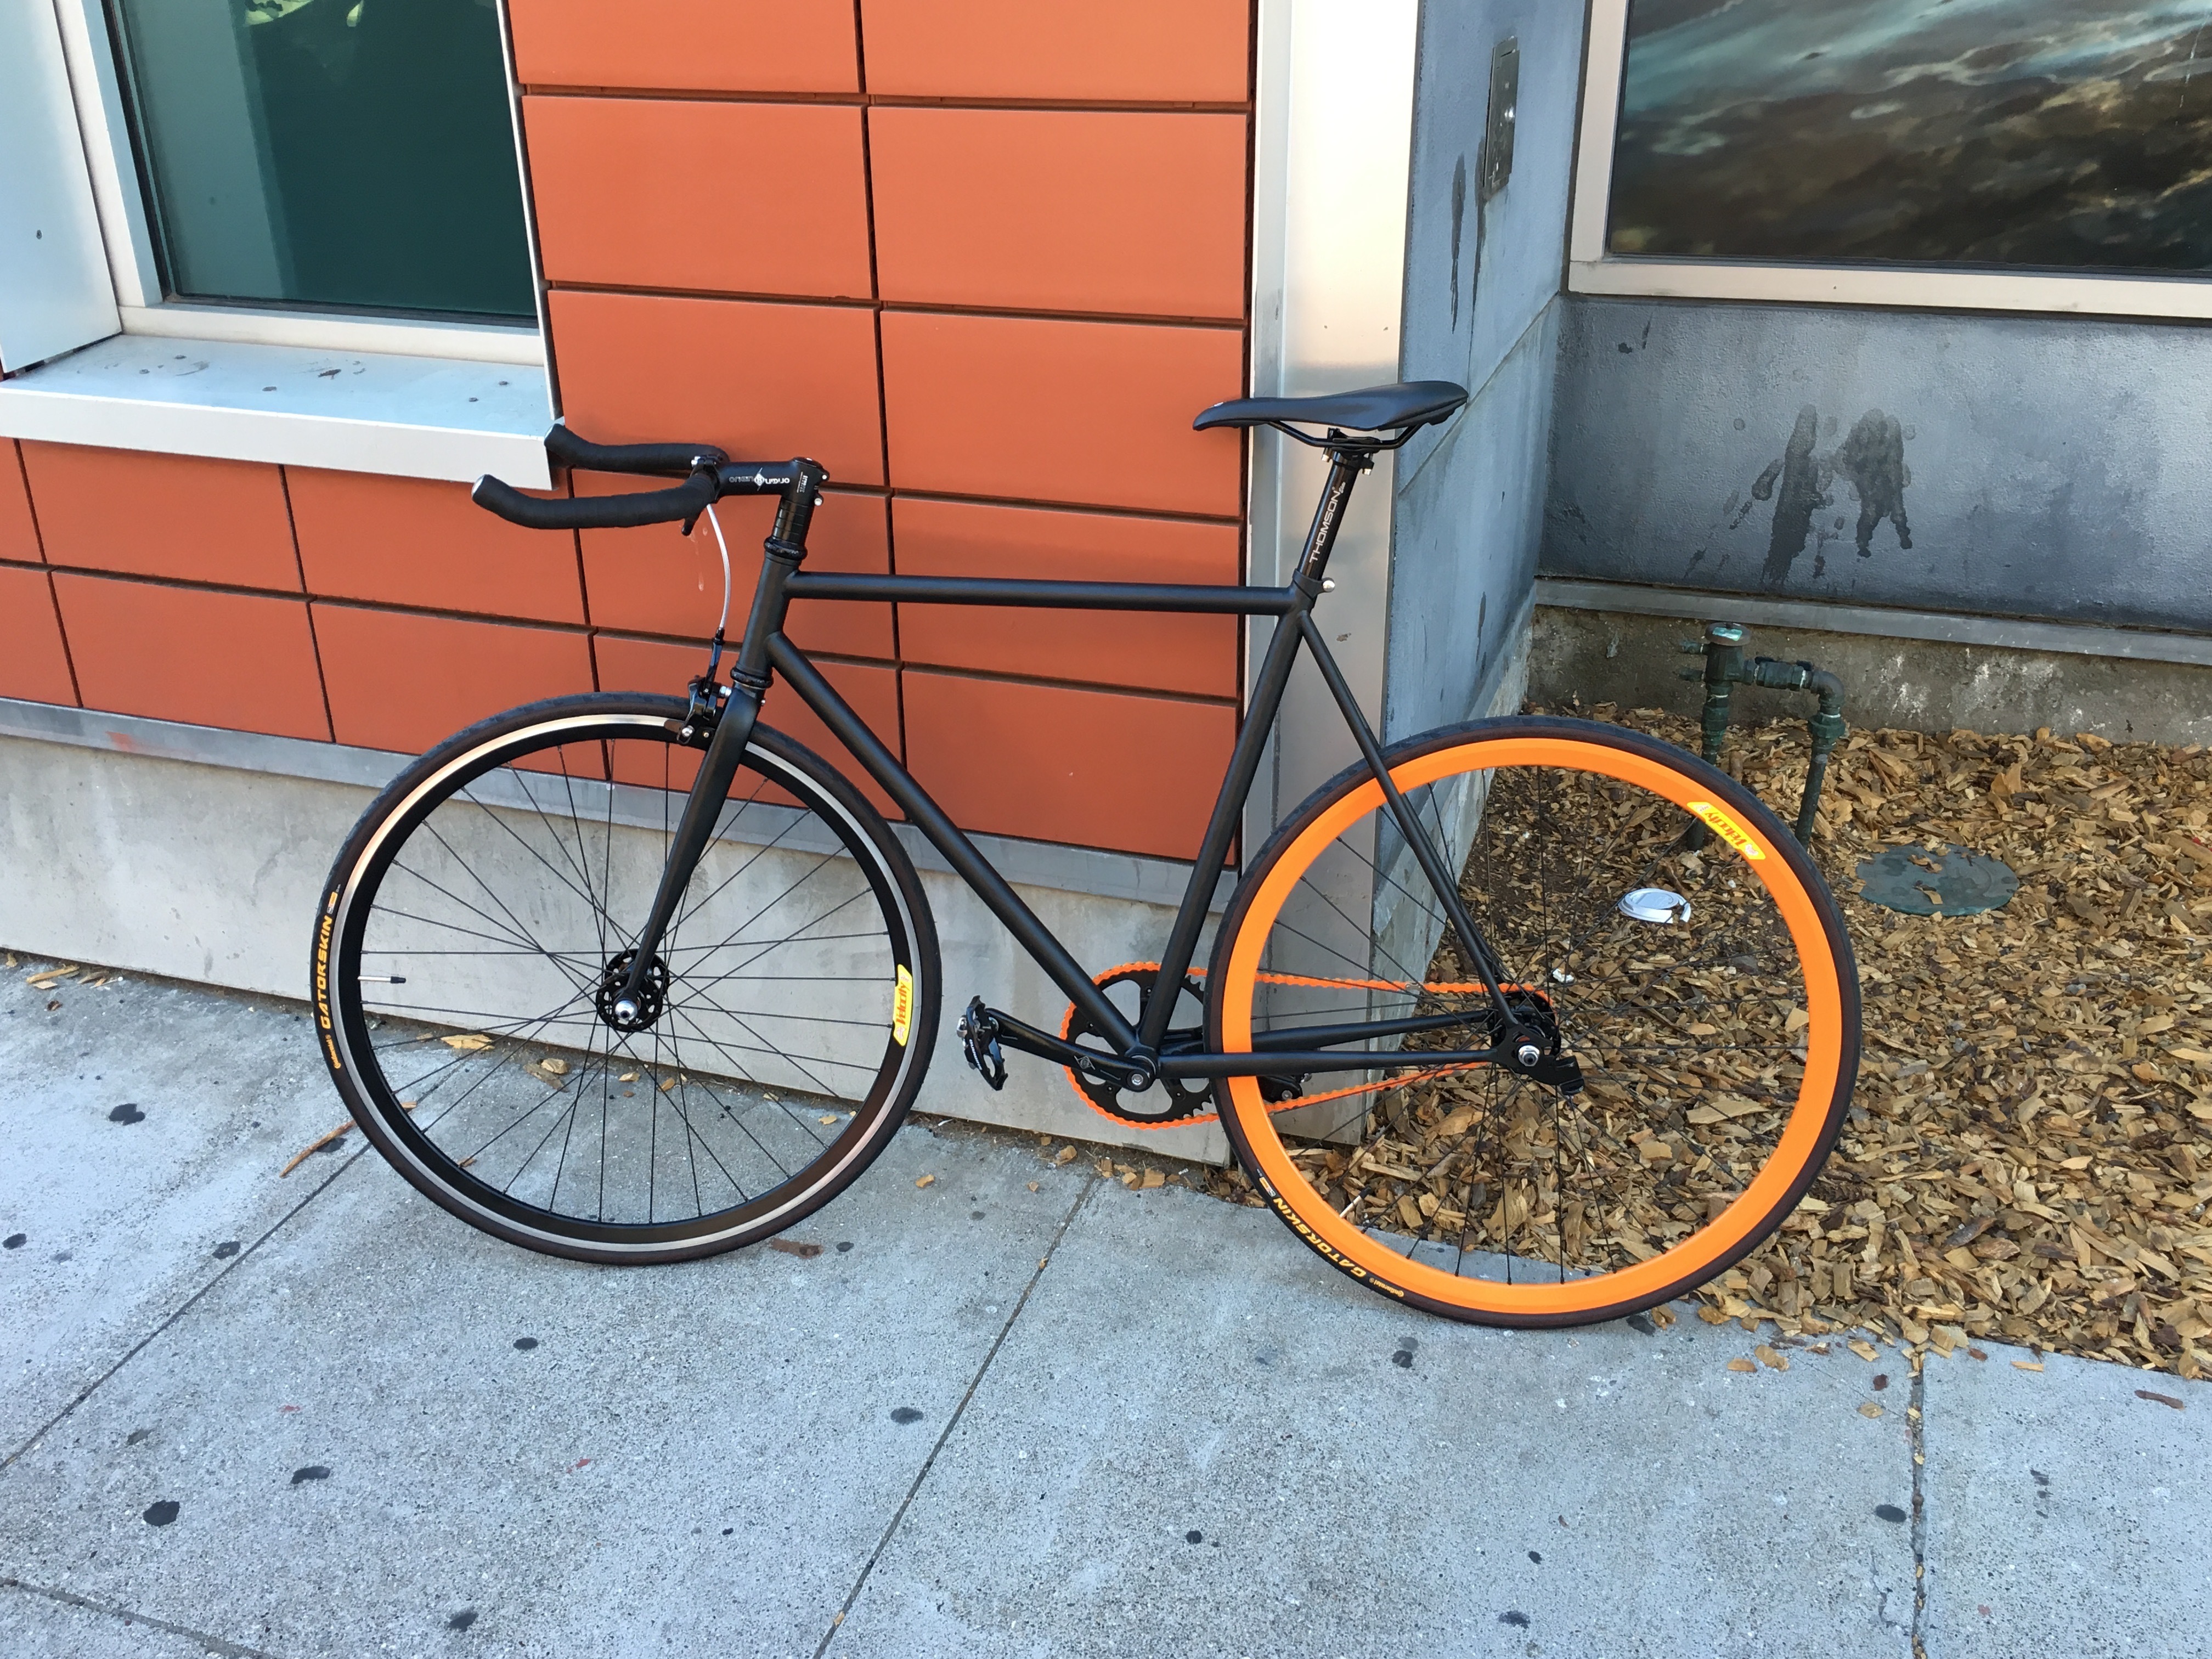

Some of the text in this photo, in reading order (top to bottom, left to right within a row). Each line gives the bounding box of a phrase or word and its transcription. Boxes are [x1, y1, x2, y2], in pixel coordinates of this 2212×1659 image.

[1309, 490, 1340, 563] THOMSON
[1705, 812, 1747, 846] Velocity
[317, 915, 332, 1029] GATORSKIN
[1273, 1198, 1366, 1277] GATORSKIN
